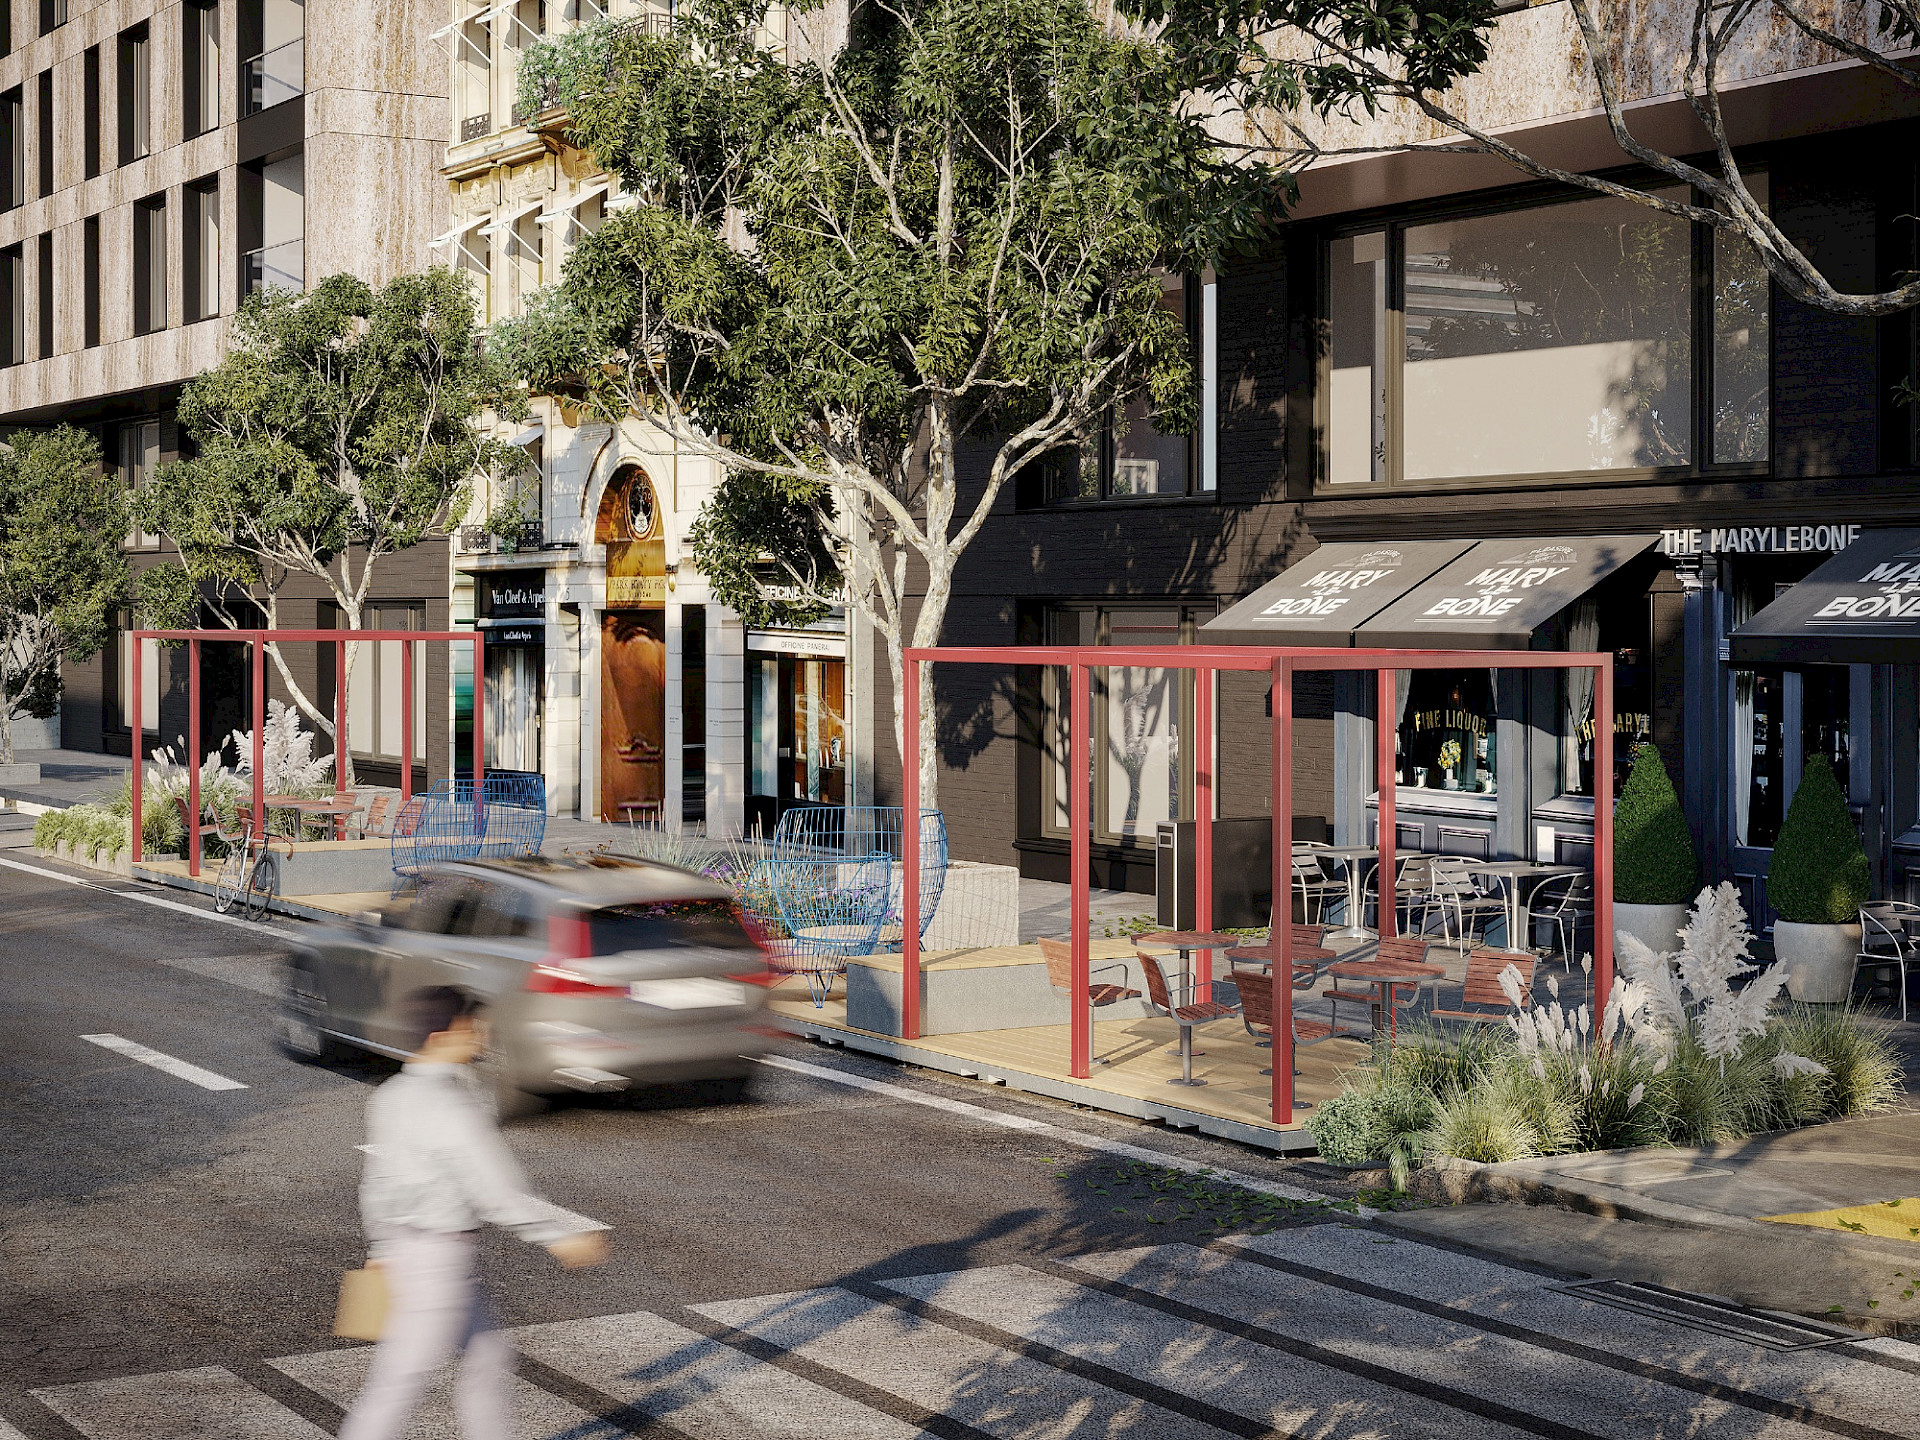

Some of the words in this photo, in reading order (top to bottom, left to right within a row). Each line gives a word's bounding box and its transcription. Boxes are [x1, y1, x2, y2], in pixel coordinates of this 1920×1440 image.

[1660, 529, 1701, 553] THE
[1300, 569, 1396, 589] MARY
[1464, 567, 1571, 588] MARY
[1857, 562, 1920, 582] MA
[492, 590, 504, 605] Van
[505, 588, 522, 605] Cleef
[522, 591, 527, 604] &
[1260, 596, 1351, 615] BONE
[1422, 595, 1525, 616] BONE
[1414, 709, 1441, 732] FINE
[1445, 709, 1487, 737] LIQUOR
